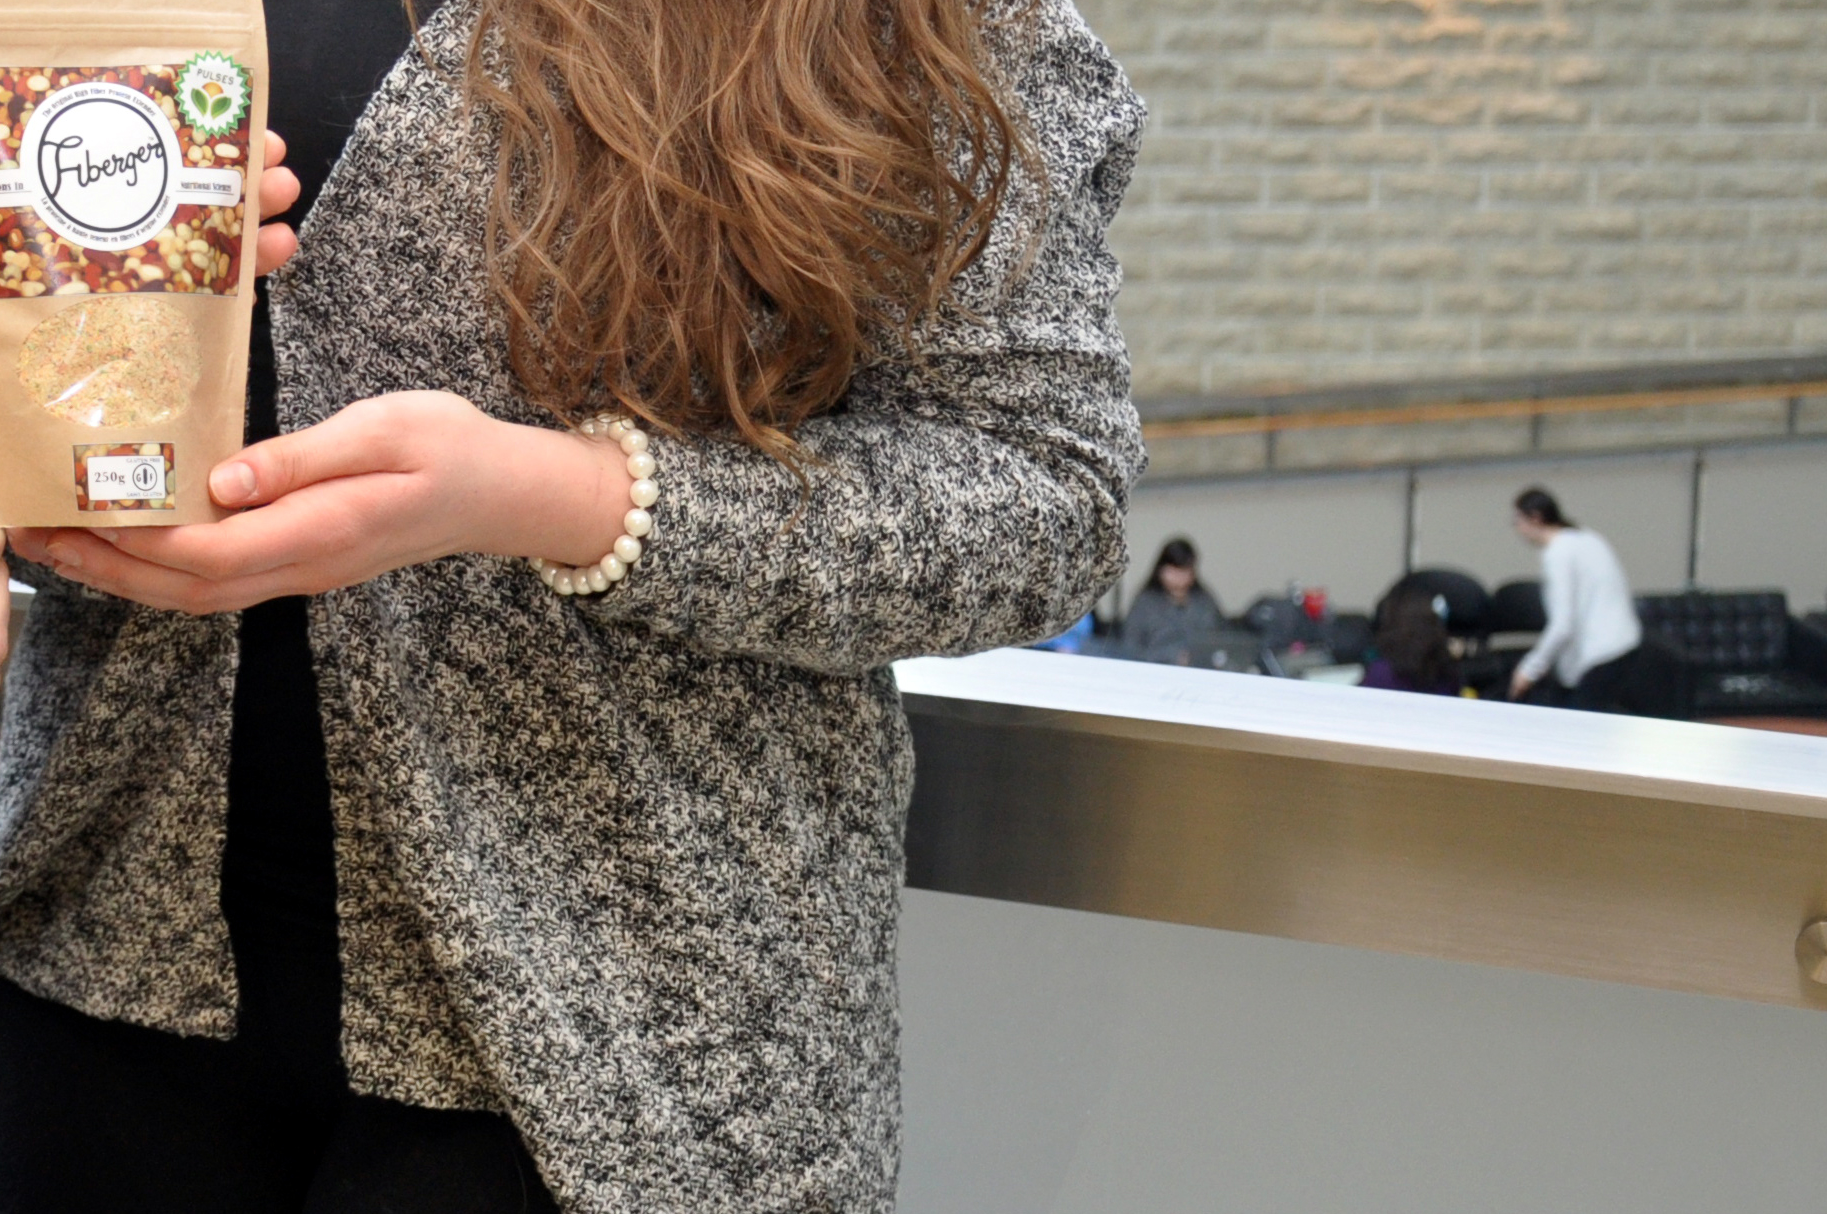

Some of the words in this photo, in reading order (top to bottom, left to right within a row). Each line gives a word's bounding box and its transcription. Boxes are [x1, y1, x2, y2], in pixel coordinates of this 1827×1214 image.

[197, 68, 234, 85] PULSES
[42, 135, 165, 198] Fiberger
[94, 471, 126, 485] 250g
